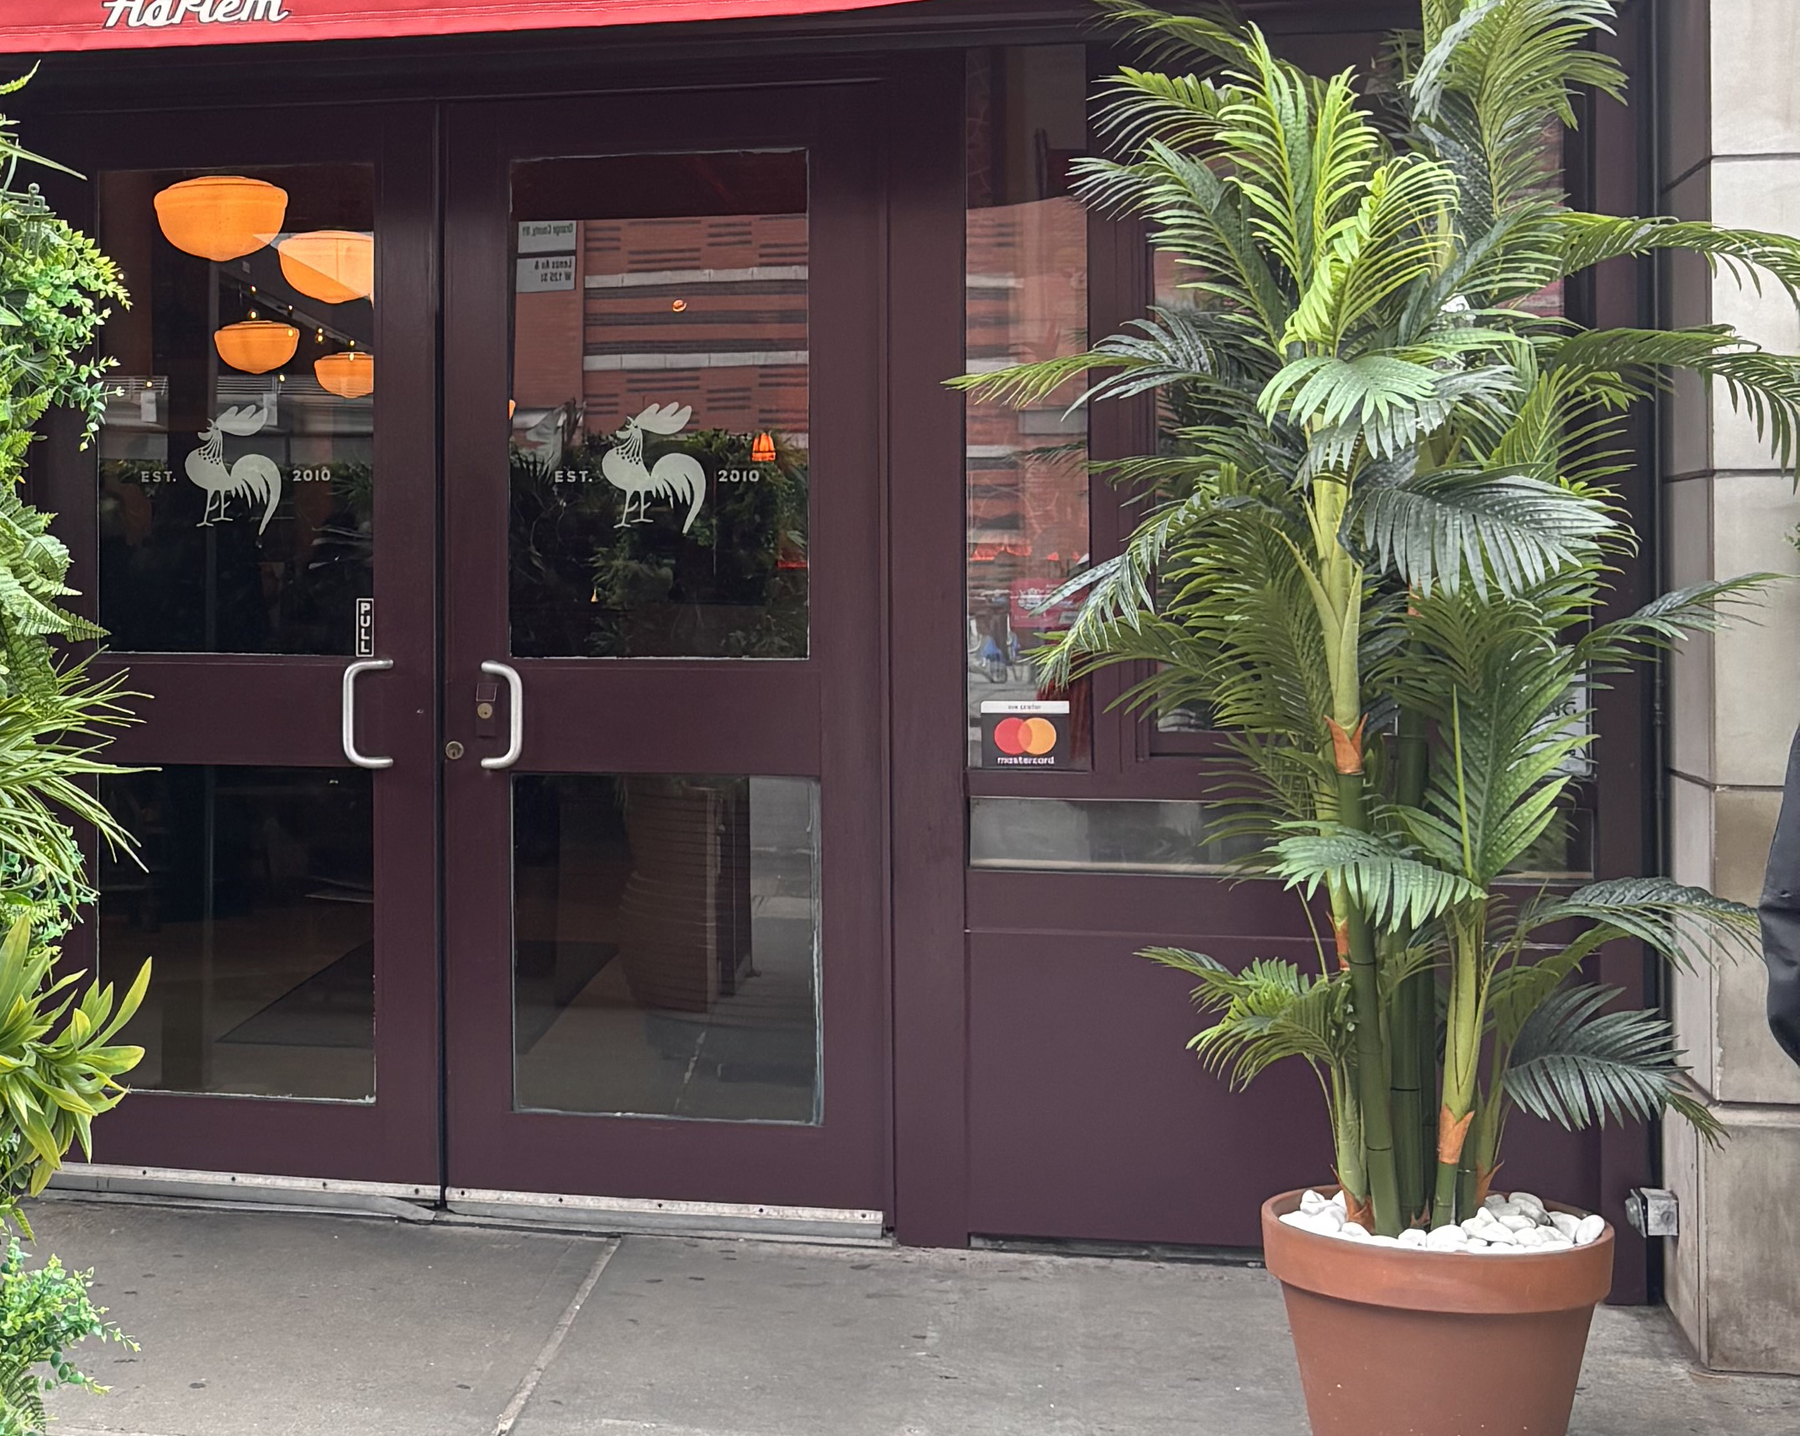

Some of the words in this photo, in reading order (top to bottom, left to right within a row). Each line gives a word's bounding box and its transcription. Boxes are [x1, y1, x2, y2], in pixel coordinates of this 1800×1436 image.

[140, 471, 177, 483] EST.
[292, 469, 331, 482] 2010
[554, 470, 593, 483] EST.
[718, 469, 760, 482] 2010
[360, 602, 371, 653] PULL
[997, 756, 1055, 765] mastercard
